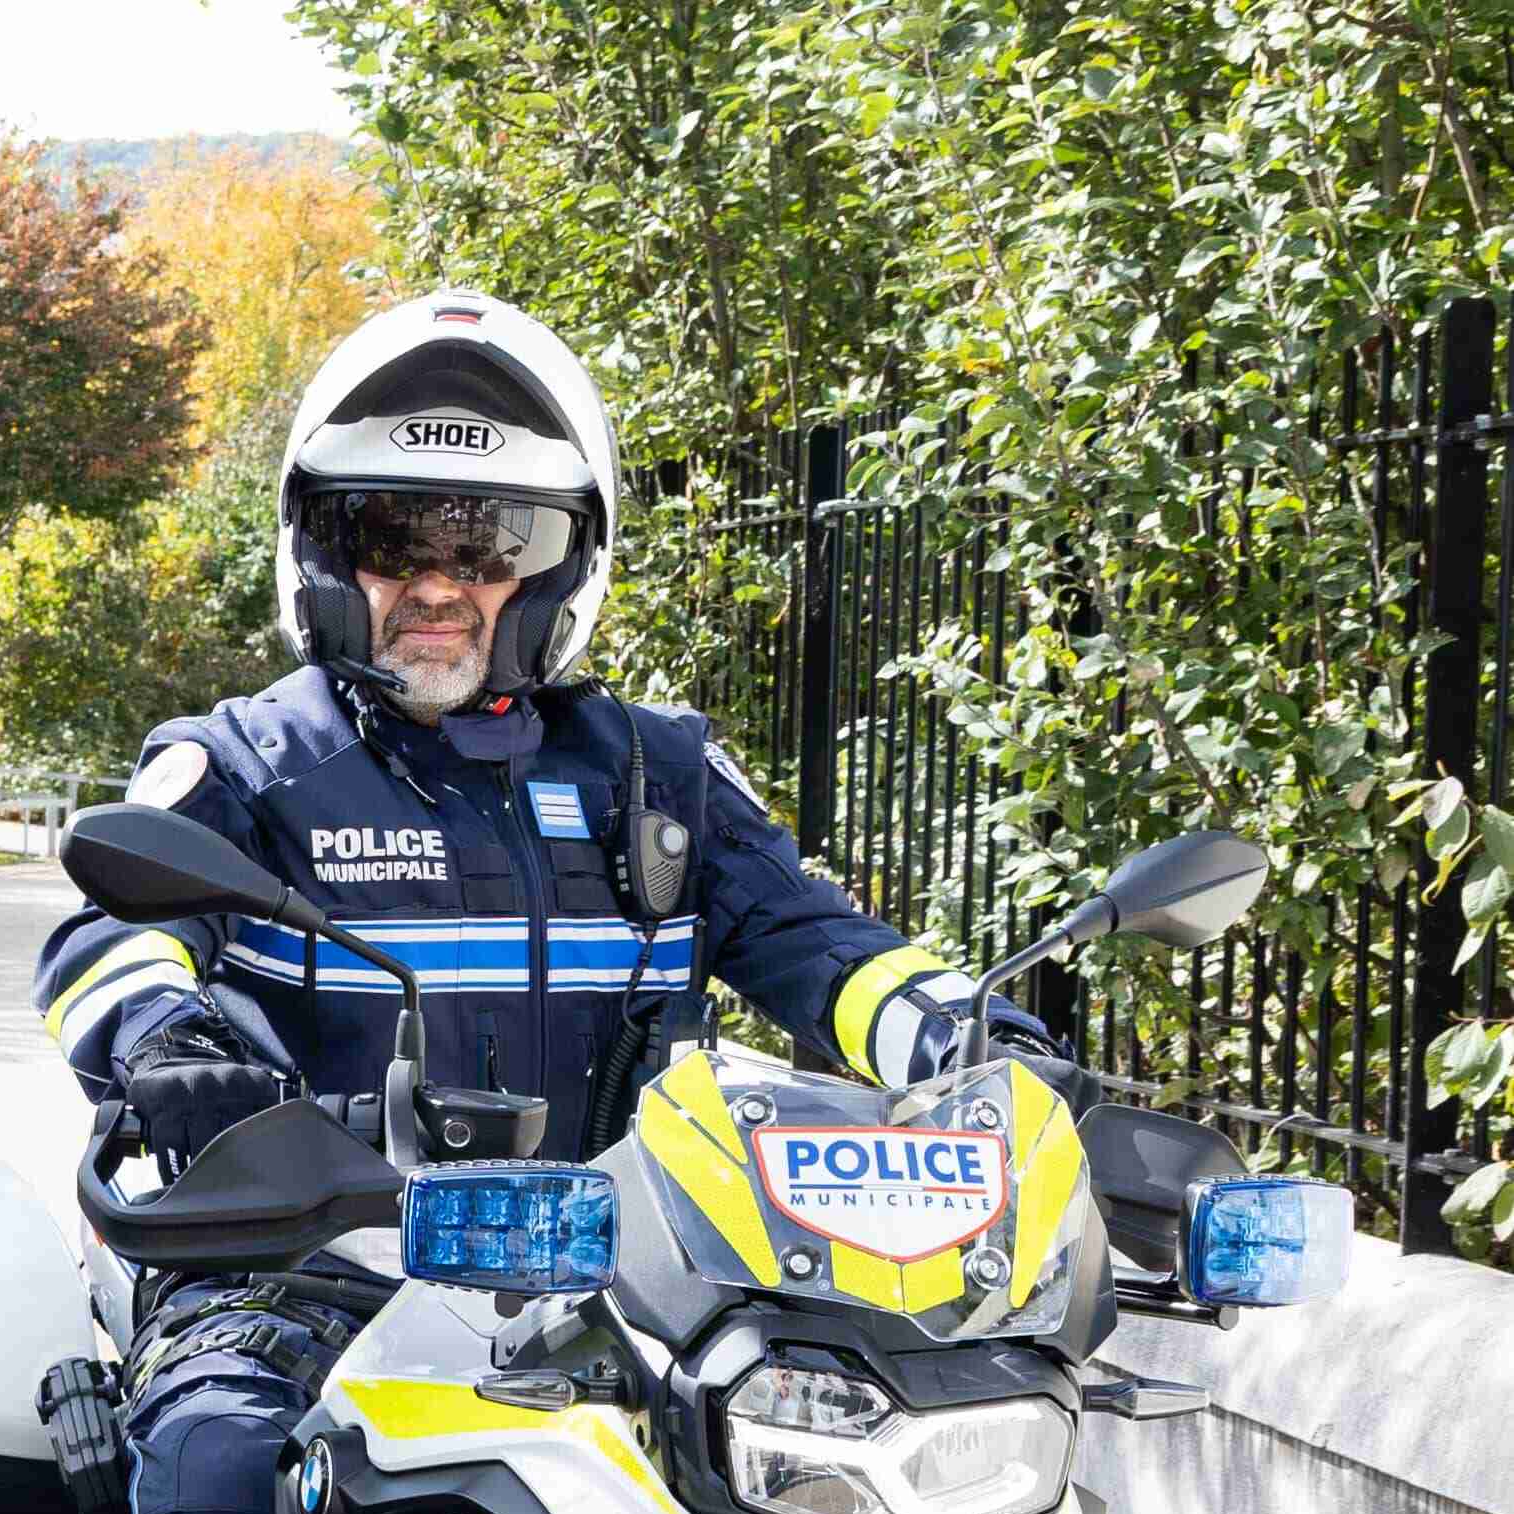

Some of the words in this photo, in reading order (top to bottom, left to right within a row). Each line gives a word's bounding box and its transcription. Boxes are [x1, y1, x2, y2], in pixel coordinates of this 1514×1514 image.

[405, 422, 490, 450] SHOEI
[310, 827, 446, 859] POLICE
[314, 861, 448, 882] MUNICIPALE
[785, 1139, 985, 1185] POLICE
[789, 1193, 991, 1211] MUNICIPALE
